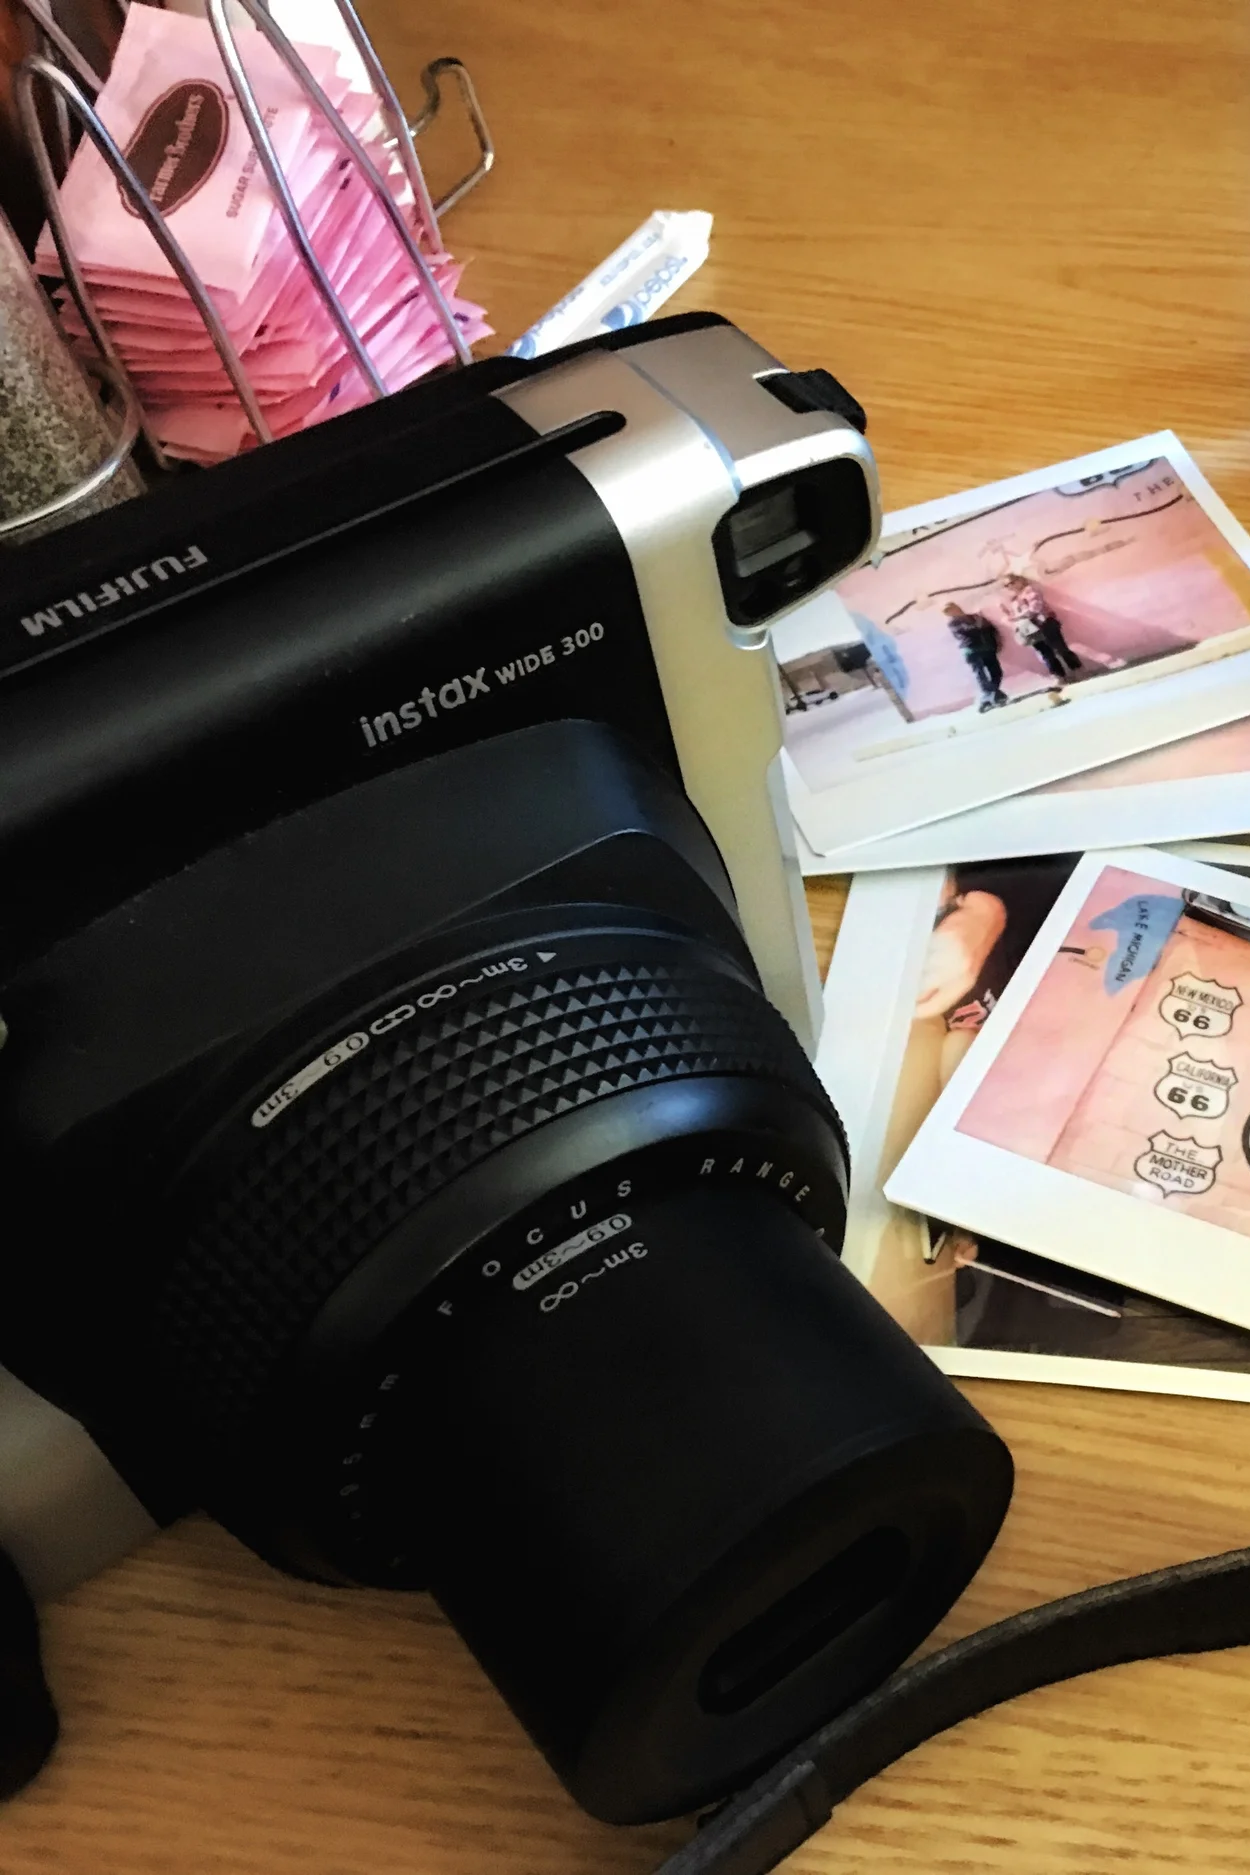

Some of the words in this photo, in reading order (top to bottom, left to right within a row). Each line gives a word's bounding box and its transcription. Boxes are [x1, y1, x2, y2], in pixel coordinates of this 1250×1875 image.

[226, 175, 250, 218] SUGAR
[243, 106, 278, 174] SUBUTE
[1133, 476, 1175, 501] THE
[21, 545, 208, 637] FUJIFILM
[360, 667, 490, 748] instax
[495, 645, 556, 685] WIDE
[561, 622, 604, 656] 300
[1135, 900, 1149, 930] LAKE
[1115, 932, 1144, 982] MICHIGAN
[1176, 985, 1197, 1000] NEW
[1199, 989, 1235, 1010] MEXICO
[1173, 1009, 1211, 1030] 66
[1176, 1061, 1231, 1086] CALIFORNIA
[1167, 1086, 1210, 1112] 66
[1165, 1142, 1198, 1160] THE
[1149, 1167, 1196, 1189] ROAD
[1150, 1154, 1208, 1180] MOTHER
[437, 1180, 632, 1315] FOCUS
[700, 1158, 810, 1202] RANGE
